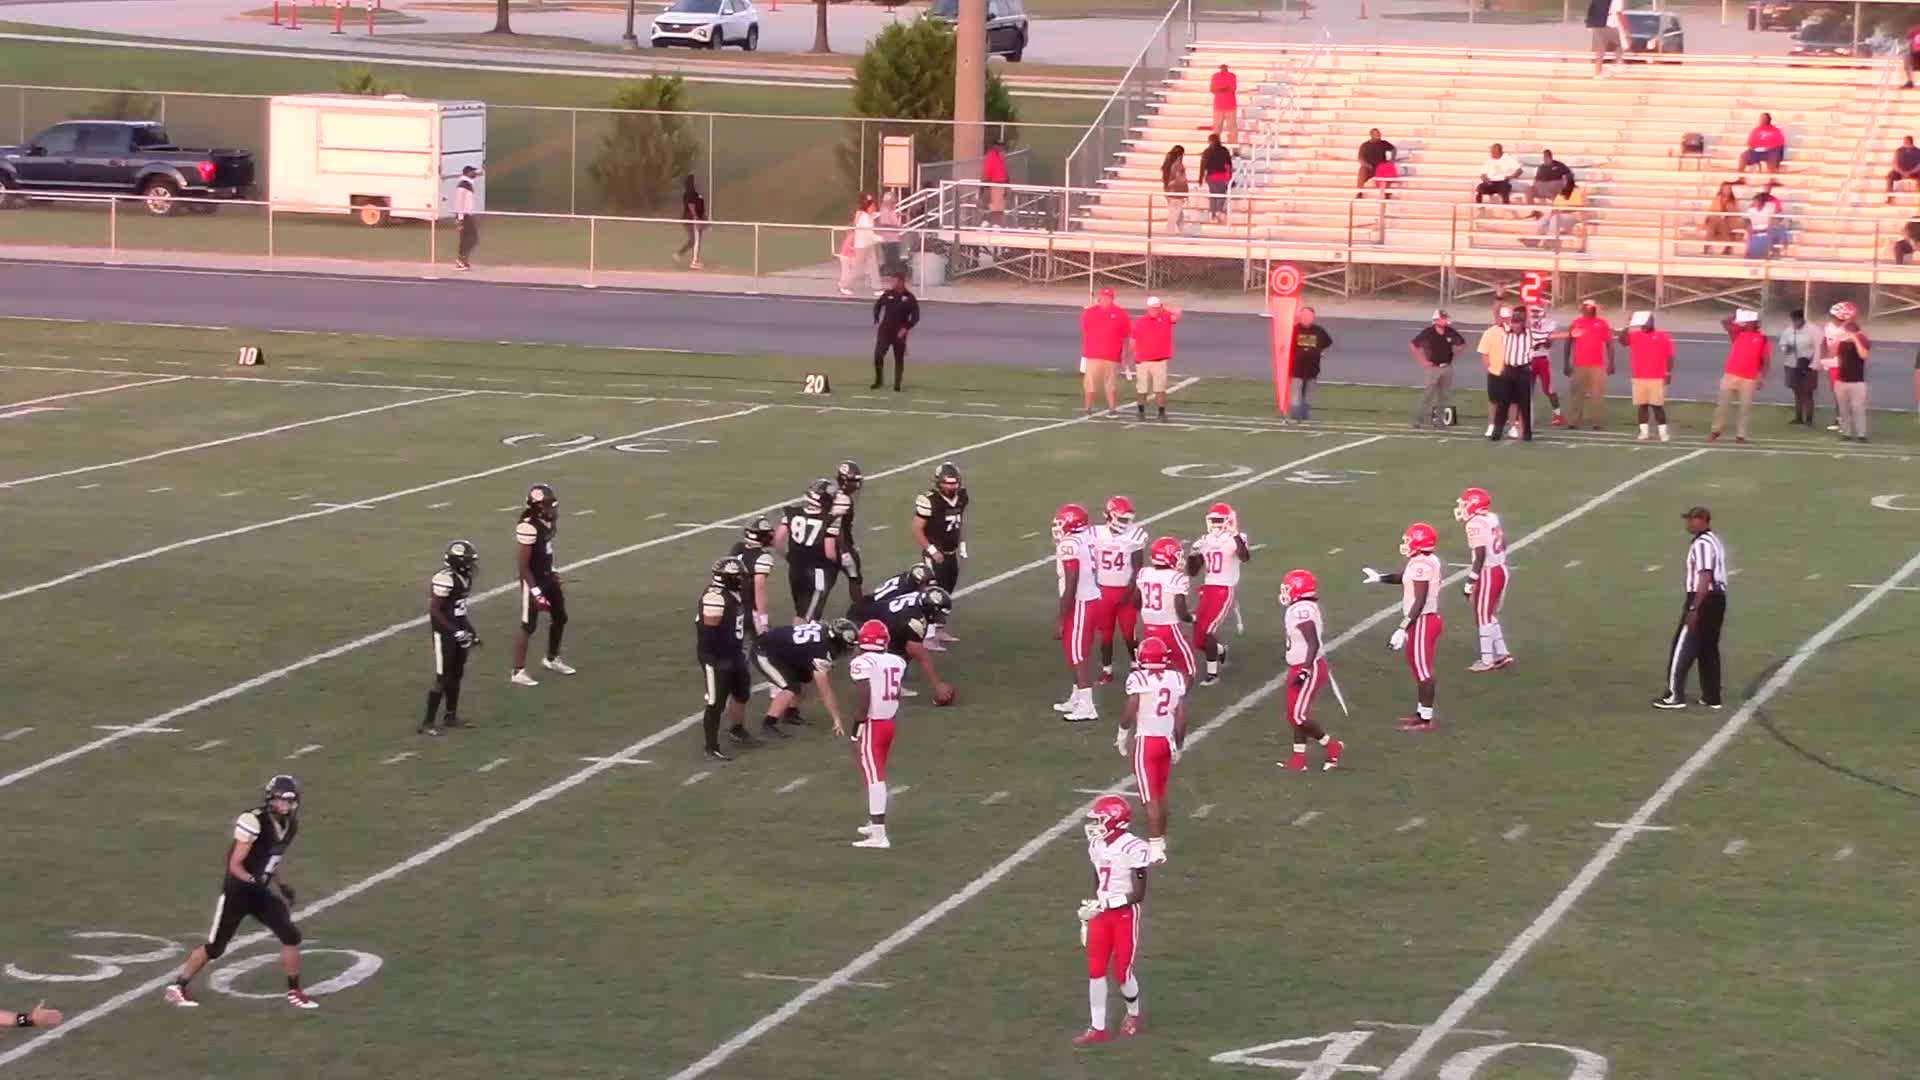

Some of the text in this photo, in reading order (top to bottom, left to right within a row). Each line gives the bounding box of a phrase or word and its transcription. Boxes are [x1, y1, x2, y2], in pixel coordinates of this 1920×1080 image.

[1521, 272, 1541, 302] 2
[239, 346, 257, 364] 10
[804, 374, 825, 393] 20
[791, 515, 823, 546] 87
[1102, 550, 1124, 571] 54
[1206, 551, 1223, 574] 10
[882, 667, 900, 701] 15
[1156, 687, 1171, 716] 2
[1140, 848, 1147, 863] 7
[1099, 866, 1112, 891] 7
